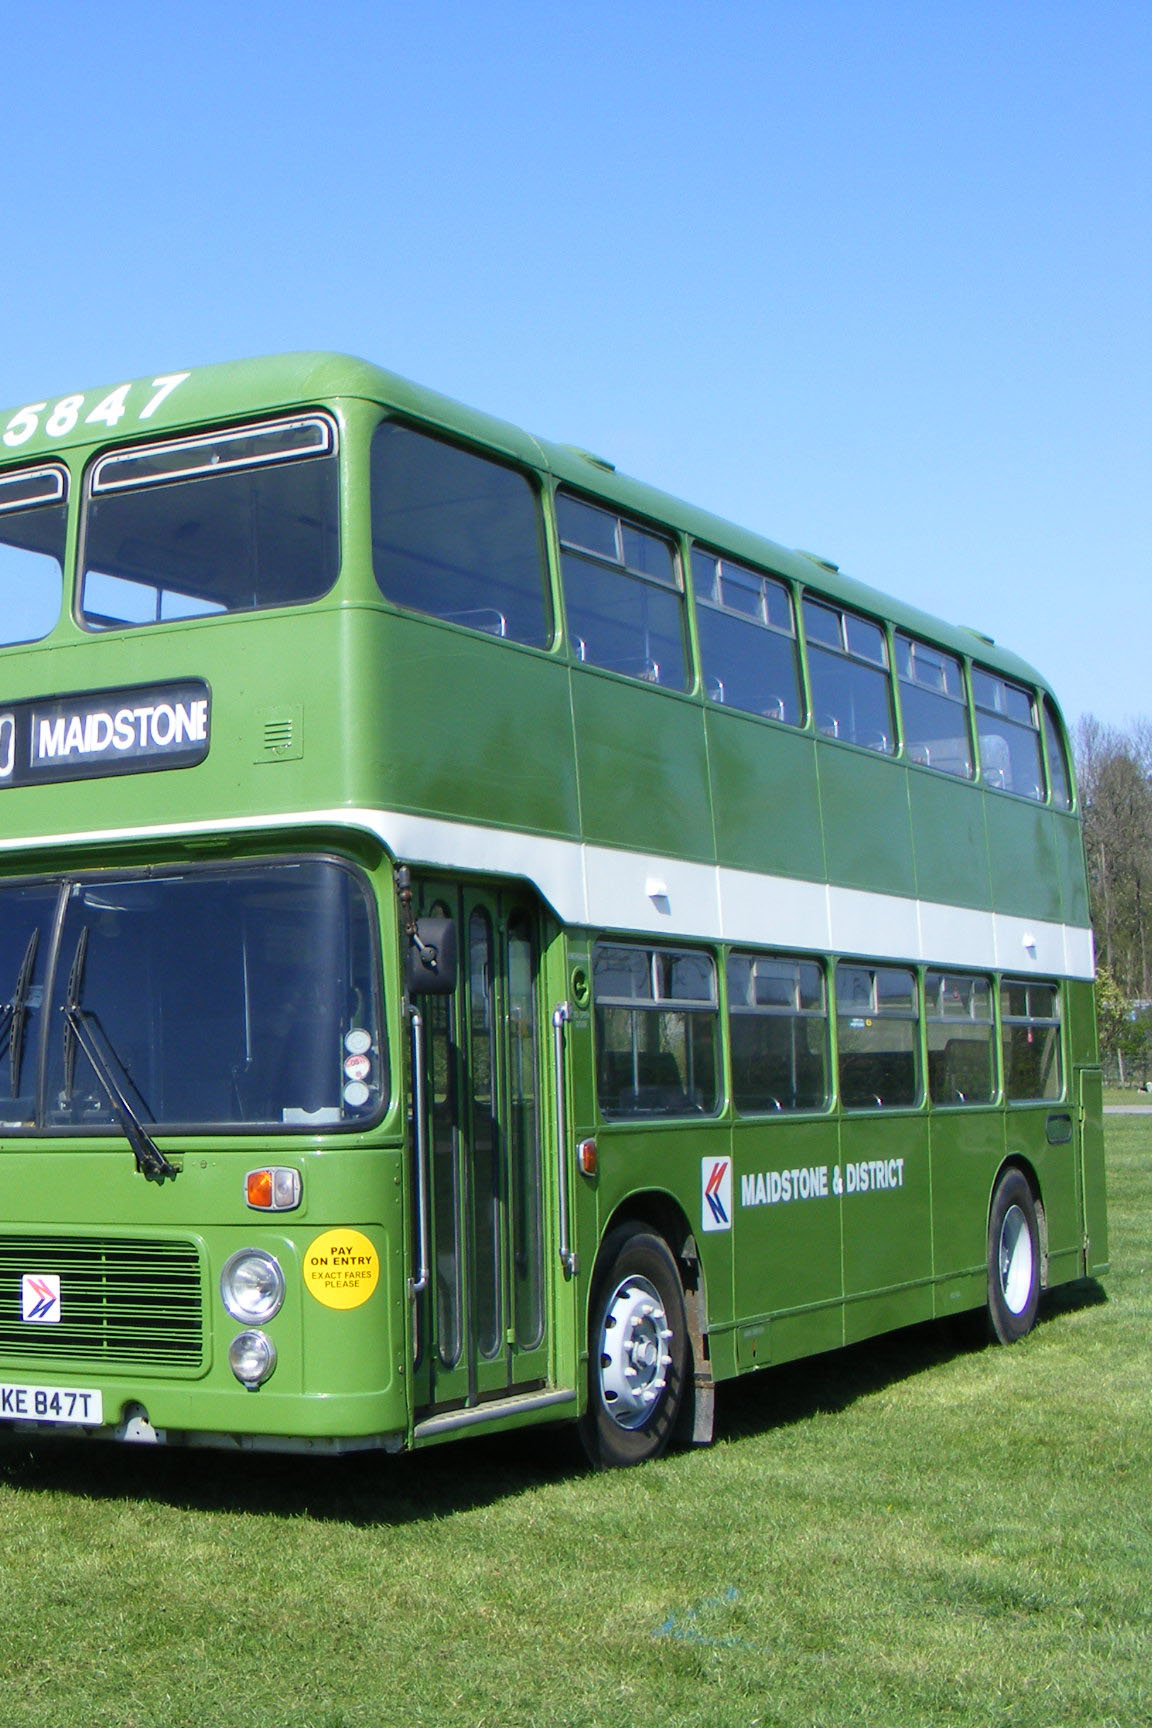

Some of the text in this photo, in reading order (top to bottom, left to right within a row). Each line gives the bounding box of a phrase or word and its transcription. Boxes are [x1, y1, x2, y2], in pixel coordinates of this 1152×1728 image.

[2, 372, 191, 447] 5847
[38, 700, 208, 759] MAIDSTONE
[741, 1158, 904, 1207] MAIDSTONE & DISTRICT
[330, 1246, 353, 1256] PAY
[310, 1256, 372, 1266] ON ENTRY
[311, 1270, 372, 1280] EXACT FARES
[324, 1279, 360, 1289] PLEASE
[34, 1390, 92, 1418] 847T
